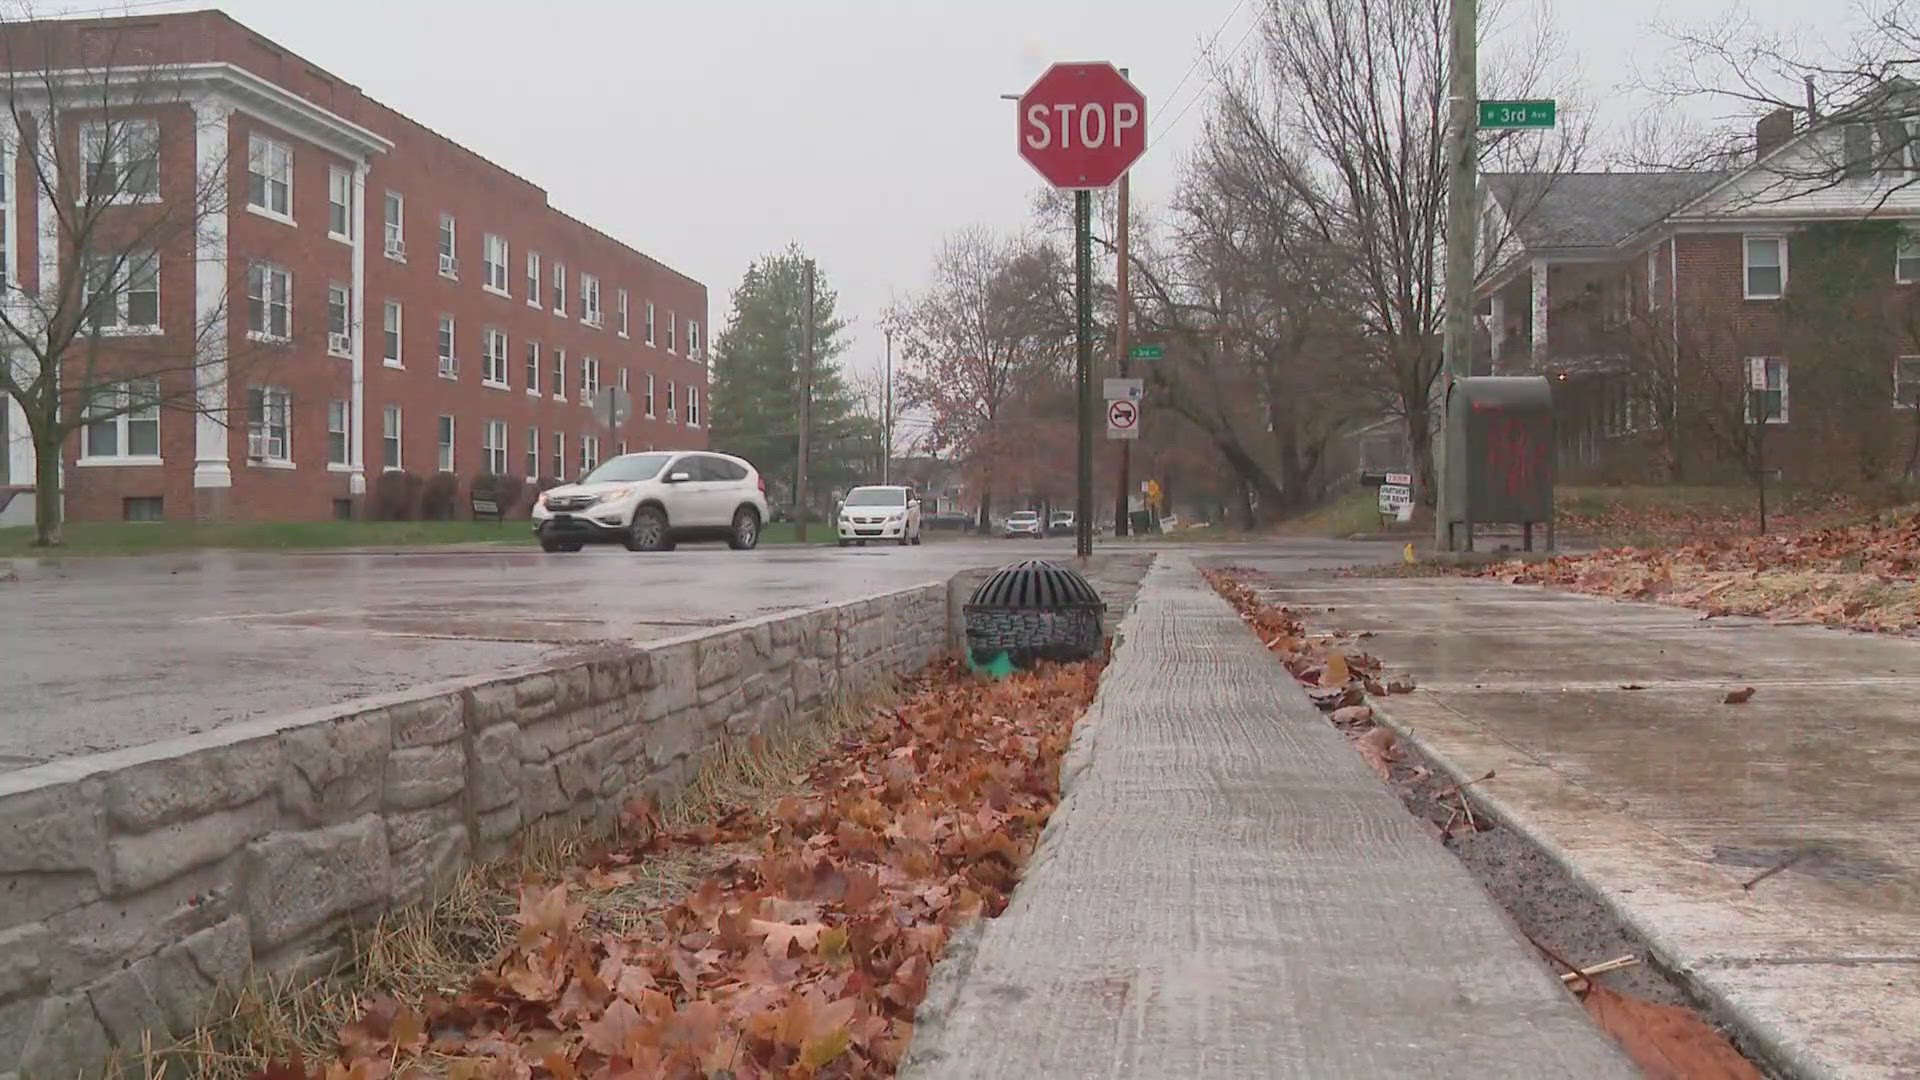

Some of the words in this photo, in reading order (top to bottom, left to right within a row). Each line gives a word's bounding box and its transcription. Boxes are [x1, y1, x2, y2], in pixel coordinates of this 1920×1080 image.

[1500, 107, 1527, 122] 3rd
[1531, 111, 1547, 119] Ave
[1026, 102, 1139, 150] STOP
[1391, 495, 1409, 503] RENT
